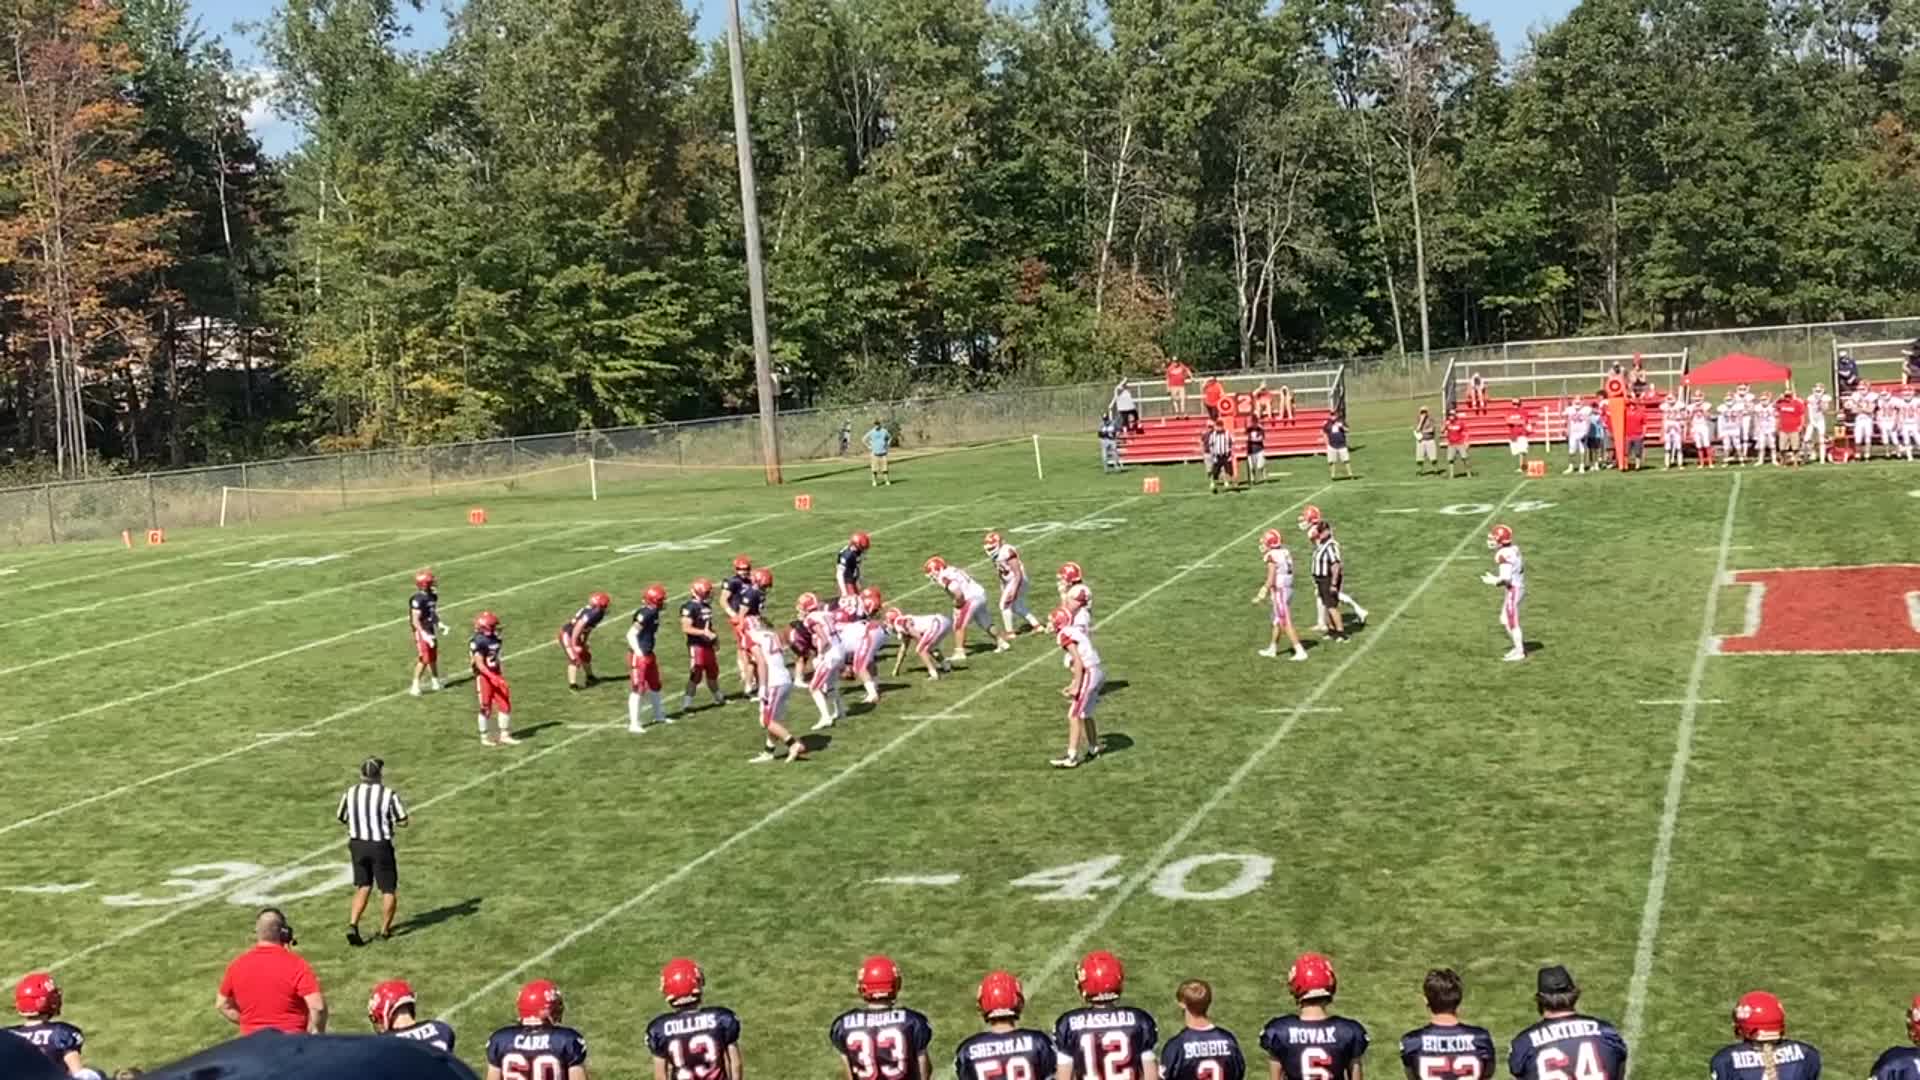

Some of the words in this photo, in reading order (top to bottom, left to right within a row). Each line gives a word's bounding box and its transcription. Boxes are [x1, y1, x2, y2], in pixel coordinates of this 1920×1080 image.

[1009, 853, 1275, 901] 40
[664, 1013, 716, 1035] COLLINS
[1069, 1011, 1136, 1031] BRASSARD
[1529, 1020, 1601, 1047] MARTINEZ
[514, 1034, 550, 1050] CARR
[969, 1035, 1033, 1060] SHERMAN
[1288, 1026, 1337, 1044] NOVAK
[846, 1027, 906, 1079] 33
[1080, 1030, 1131, 1080] 12
[1183, 1039, 1232, 1059] BOBBIE
[1536, 1041, 1605, 1080] 64
[1301, 1047, 1332, 1080] 6
